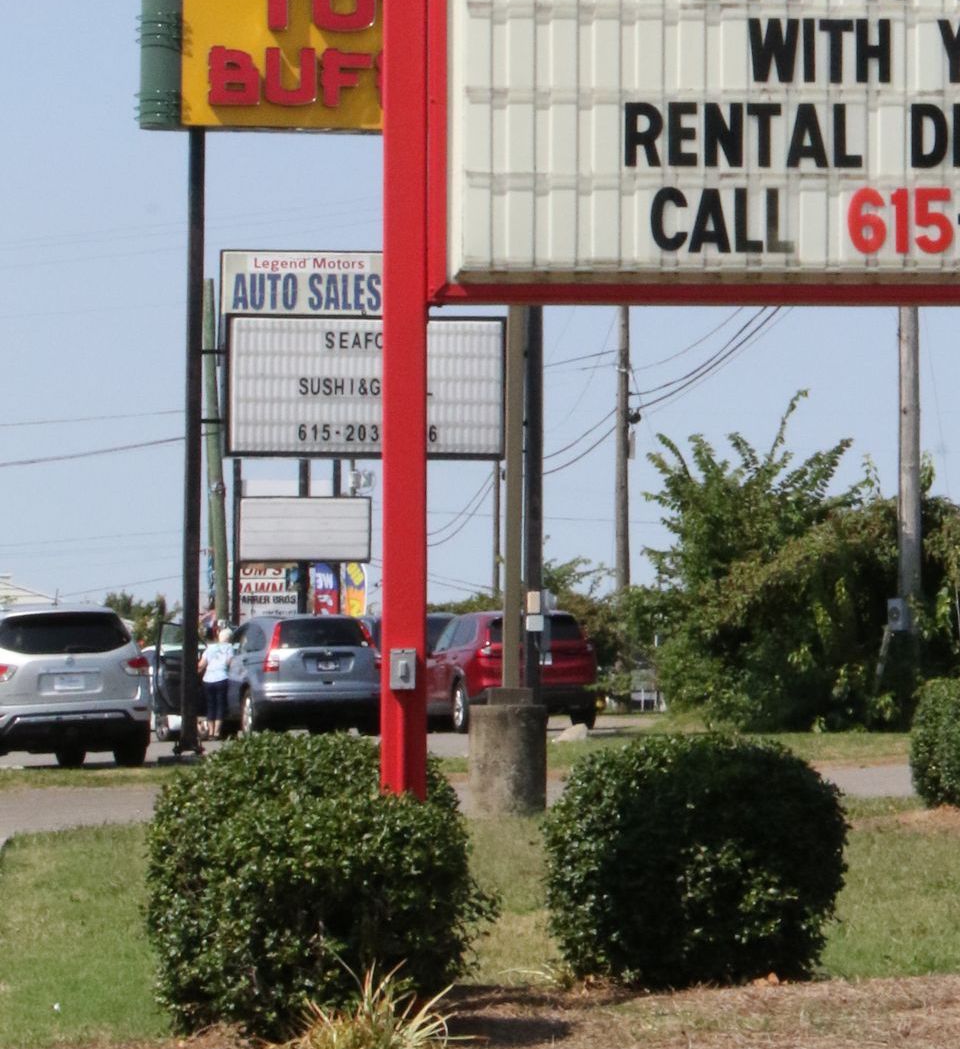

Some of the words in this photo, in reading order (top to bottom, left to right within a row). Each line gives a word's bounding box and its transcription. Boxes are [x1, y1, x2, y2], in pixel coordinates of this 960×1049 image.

[208, 45, 383, 108] BUF
[748, 18, 891, 84] WITH
[625, 102, 862, 168] RENTAL
[651, 187, 796, 254] CALL
[232, 273, 298, 310] AUTO
[308, 273, 381, 311] SALES
[254, 257, 306, 272] Legend
[313, 258, 365, 270] Motors
[325, 331, 383, 349] SEAFO
